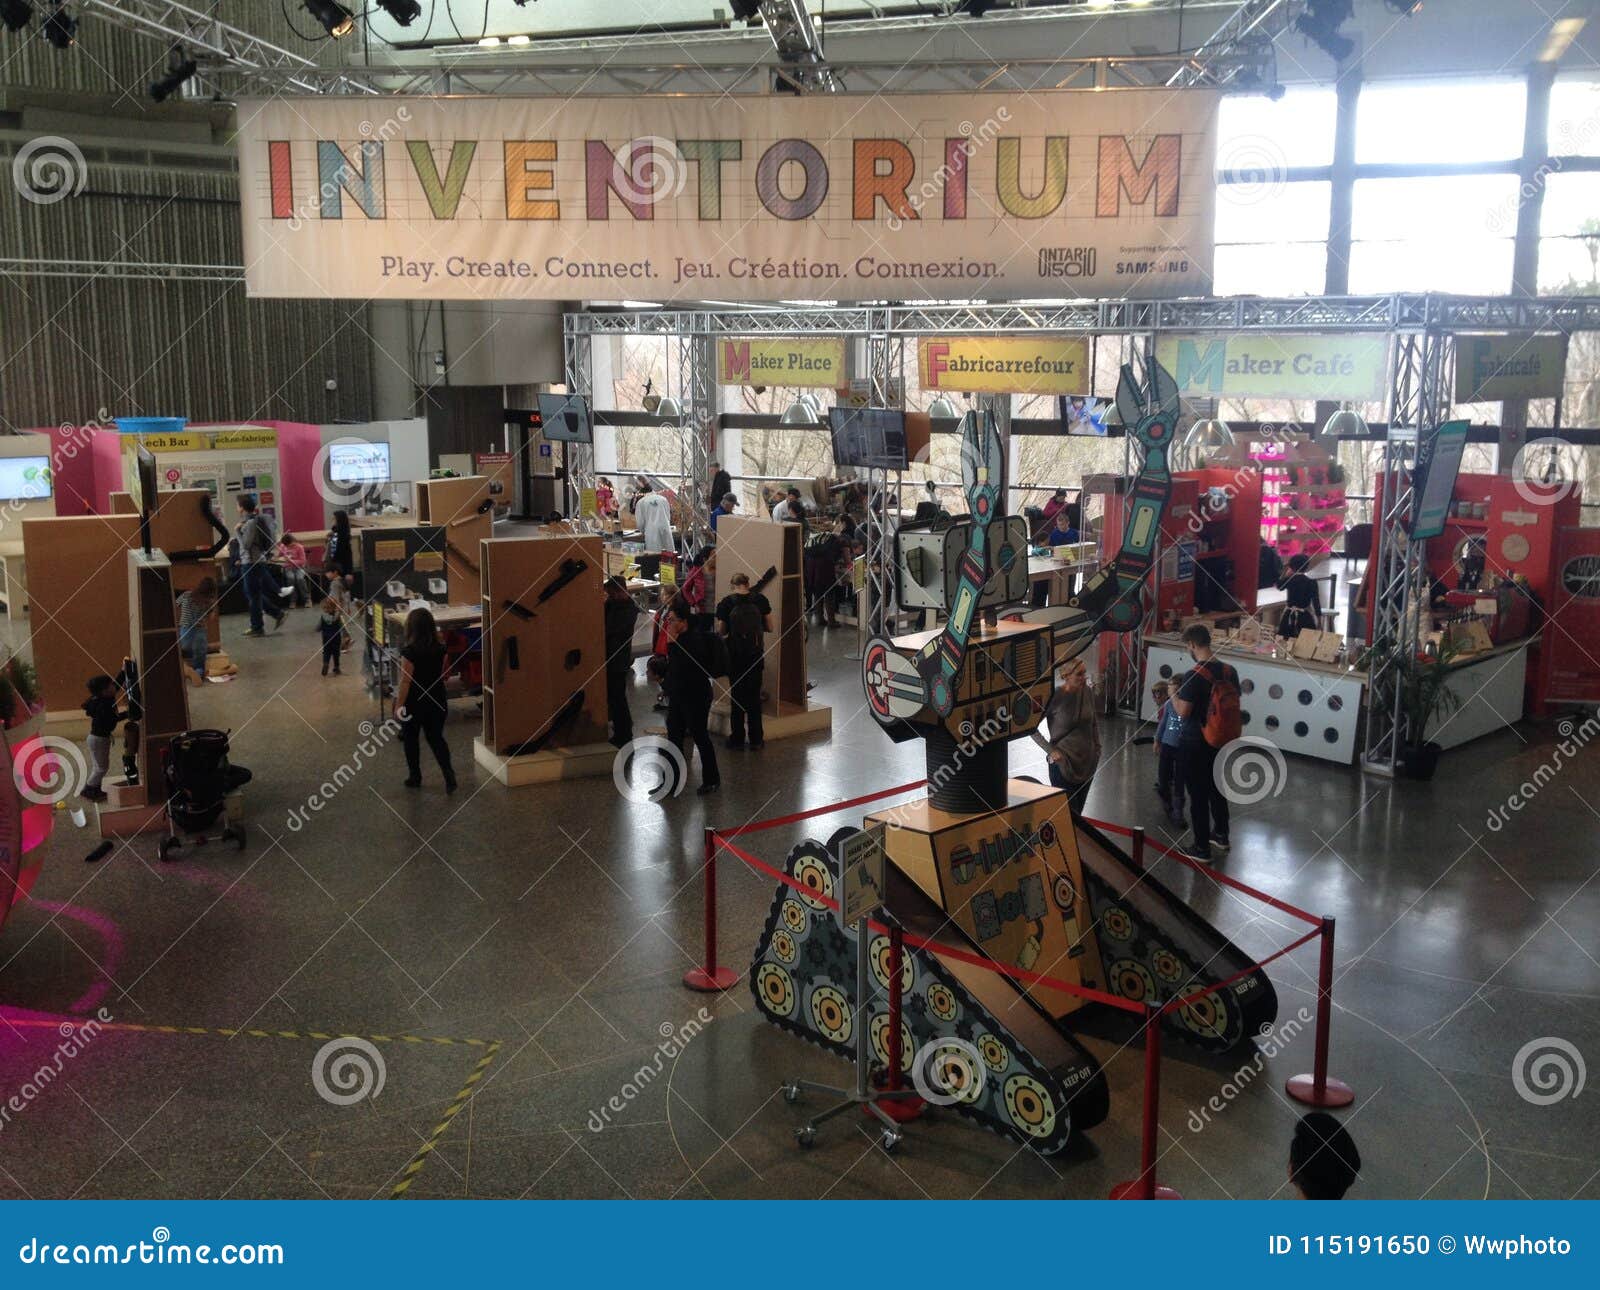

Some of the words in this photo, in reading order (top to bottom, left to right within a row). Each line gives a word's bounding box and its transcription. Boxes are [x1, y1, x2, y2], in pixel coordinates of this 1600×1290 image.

[268, 136, 1182, 220] INVENTORIUM
[381, 256, 439, 283] Play.
[446, 256, 538, 279] Create.
[545, 256, 658, 279] Connect.
[674, 257, 720, 283] Jeu.
[728, 256, 847, 279] Création.
[855, 256, 1005, 279] Connexion.
[1116, 260, 1189, 274] SAMSUNG
[725, 341, 784, 381] Maker
[788, 352, 832, 371] Place
[927, 342, 1074, 387] Fabricarrefour
[1175, 339, 1286, 392] Maker
[1292, 352, 1354, 376] Café
[169, 437, 190, 447] Bar
